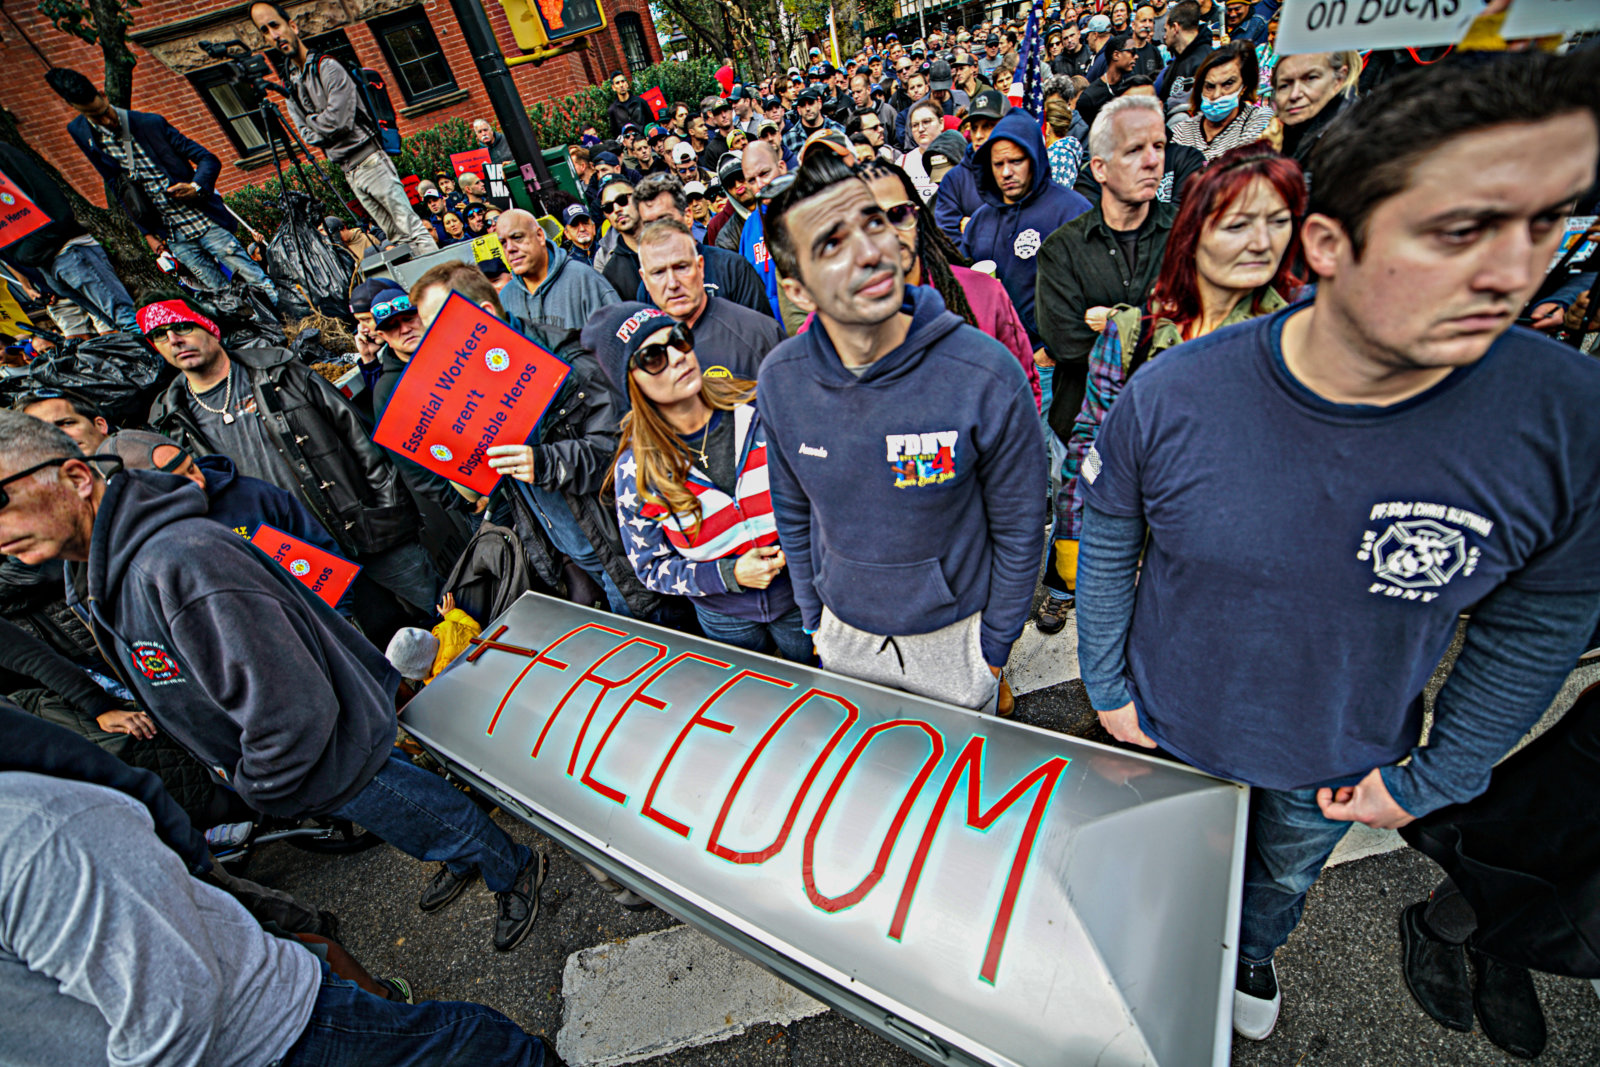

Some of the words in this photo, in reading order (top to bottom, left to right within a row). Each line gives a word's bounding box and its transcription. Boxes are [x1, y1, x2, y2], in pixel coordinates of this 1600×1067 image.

[1306, 0, 1348, 31] on
[402, 392, 444, 453] Essential
[435, 322, 488, 391] Workers
[451, 388, 484, 435] aren't
[457, 411, 507, 476] Disposable
[500, 363, 537, 409] Heros
[886, 430, 958, 462] FDNY
[312, 566, 333, 593] eros
[1368, 583, 1439, 602] FDNY
[486, 622, 1072, 989] FREEDOM
